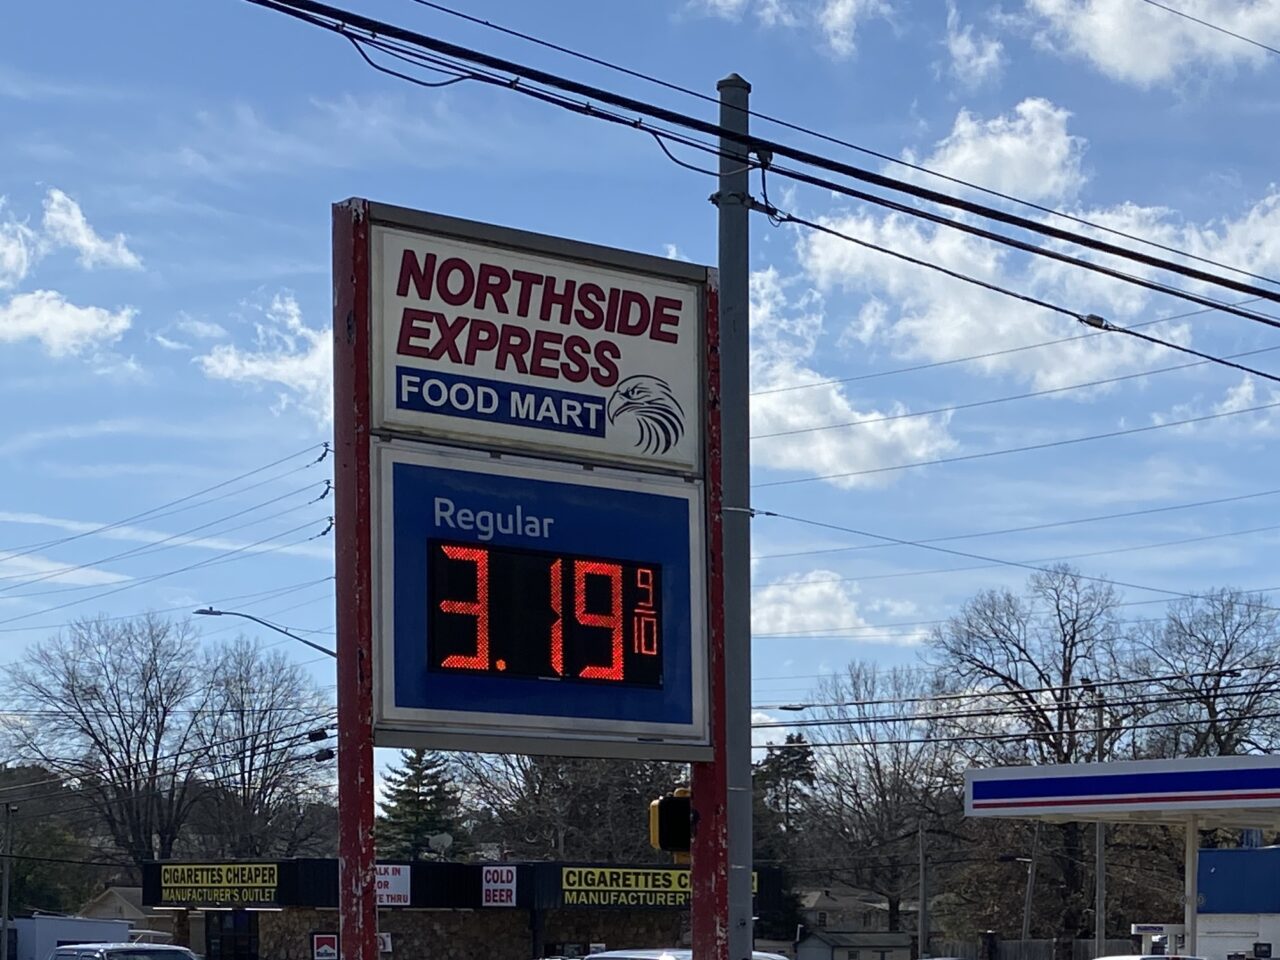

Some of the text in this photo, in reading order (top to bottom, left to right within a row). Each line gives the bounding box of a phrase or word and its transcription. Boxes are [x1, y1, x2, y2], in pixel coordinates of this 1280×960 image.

[396, 249, 682, 344] NORTHSIDE
[396, 308, 621, 388] EXPRESS
[401, 374, 603, 430] FOOD MART
[433, 497, 554, 541] Regular
[439, 545, 624, 681] 3.19
[163, 867, 276, 884] CIGARETTES CHEAPER
[374, 866, 389, 877] ALK
[485, 869, 514, 884] COLD
[565, 870, 673, 889] CIGARETTES
[162, 888, 276, 901] MANUFACTURER'S OUTLET
[485, 888, 513, 903] BEER
[564, 890, 691, 906] MANUFACTURER'
